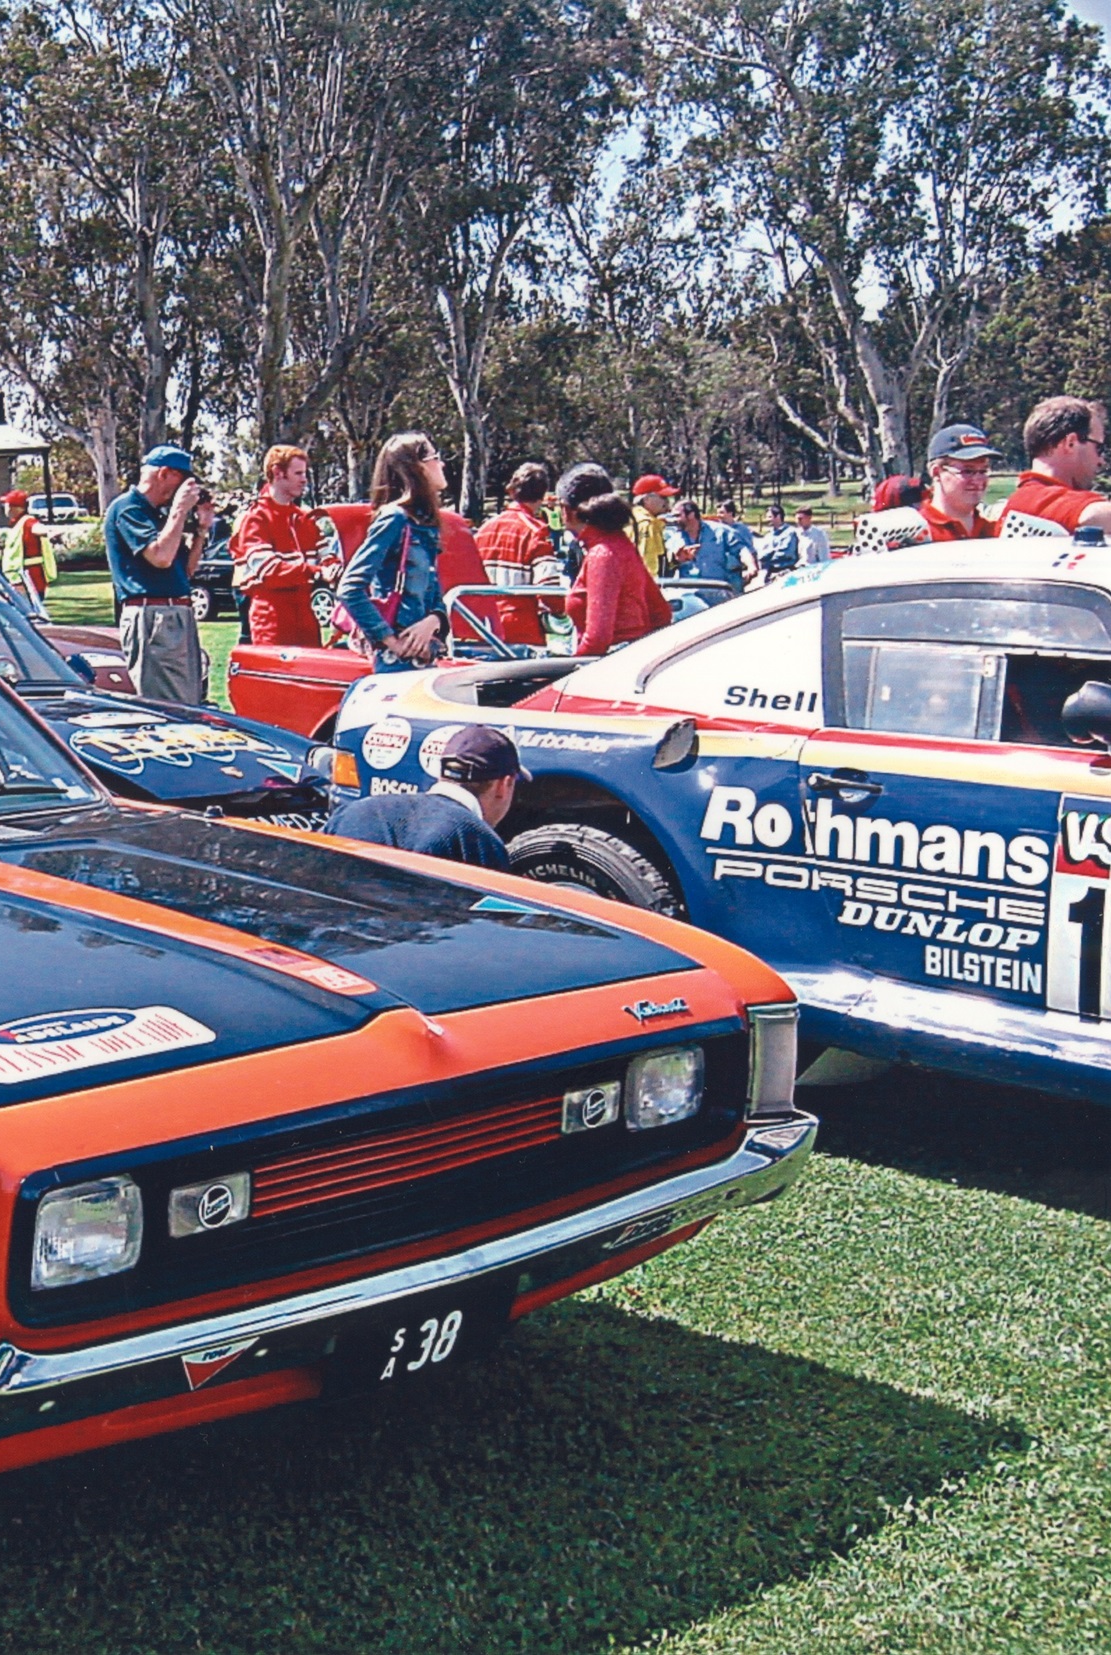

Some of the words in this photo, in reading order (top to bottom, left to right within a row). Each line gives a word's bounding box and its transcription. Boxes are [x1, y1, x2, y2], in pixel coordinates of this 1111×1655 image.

[724, 686, 818, 713] Shell
[370, 776, 419, 796] BOSCH
[714, 858, 1045, 926] PORSCHE
[838, 900, 1041, 953] DUNLOP
[924, 945, 1043, 995] BILSTEIN
[407, 1310, 463, 1371] 38
